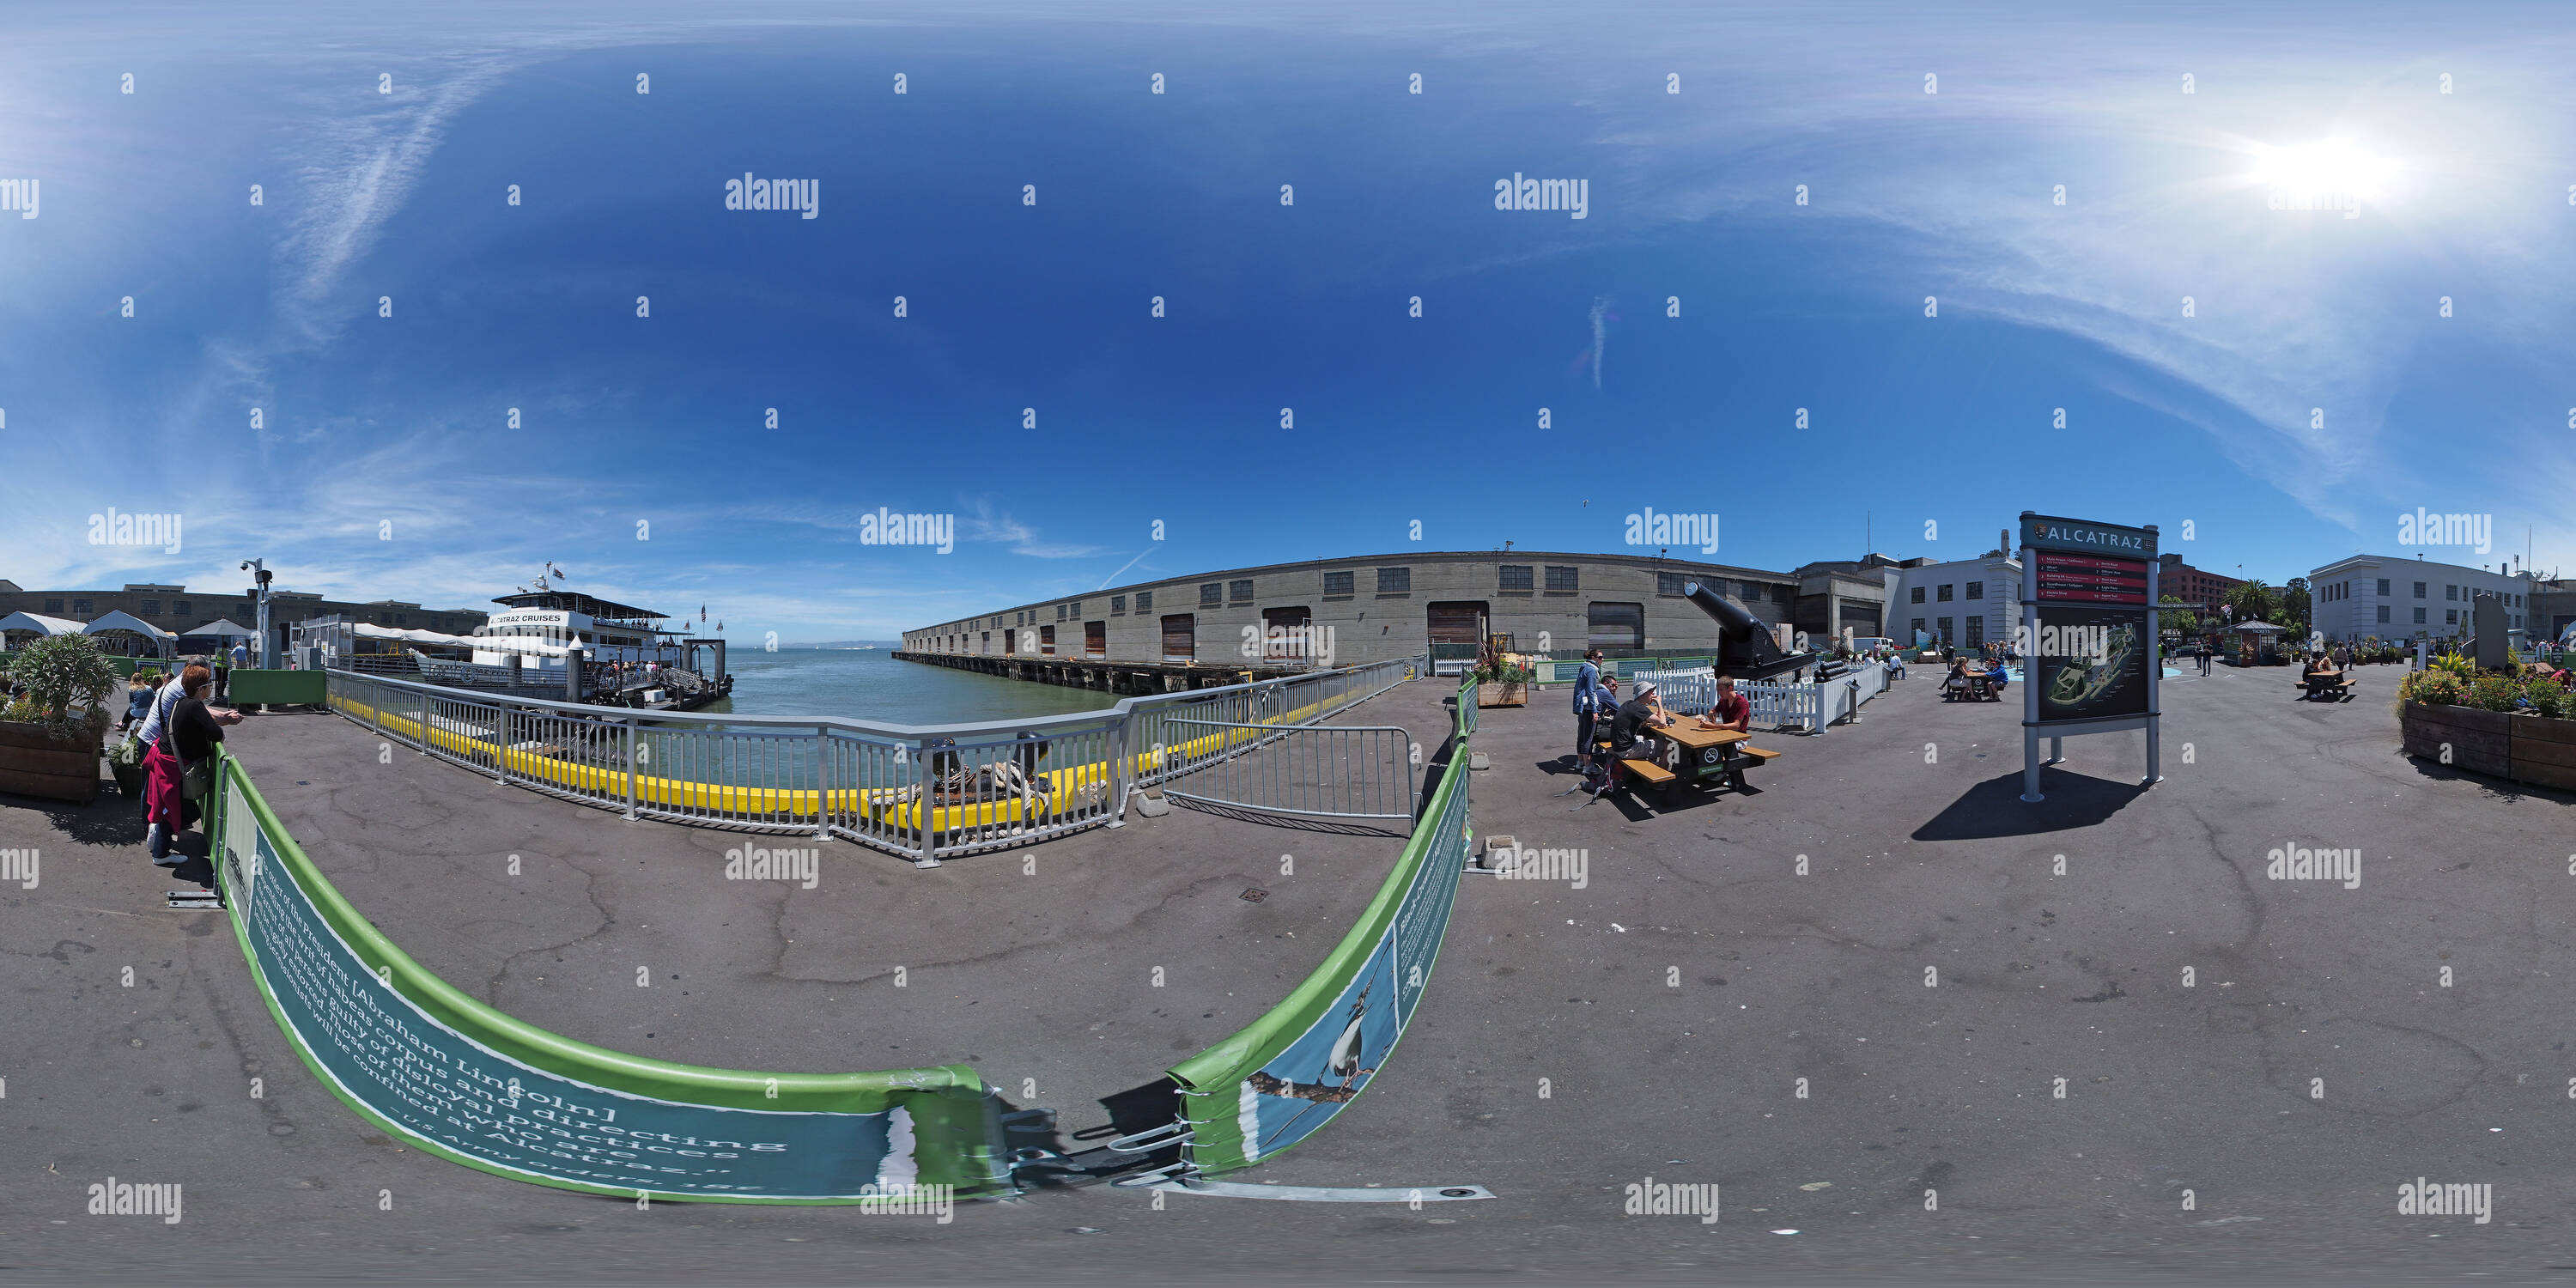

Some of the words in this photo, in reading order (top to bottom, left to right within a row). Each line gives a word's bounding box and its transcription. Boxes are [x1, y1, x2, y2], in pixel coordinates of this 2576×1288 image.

[490, 616, 520, 624] ALCATRAZ
[2047, 526, 2142, 550] ALCATRAZ
[263, 910, 270, 927] be
[289, 957, 326, 1014] enforced.
[329, 1010, 365, 1054] Those
[368, 1054, 387, 1071] of
[391, 1069, 454, 1112] them
[462, 1109, 543, 1141] who
[556, 1141, 639, 1159] are
[269, 871, 283, 897] order
[283, 895, 291, 908] of
[291, 902, 302, 927] the
[303, 921, 349, 987] President
[353, 980, 448, 1064] [Abraham
[456, 1059, 616, 1123] Lincoln]
[278, 923, 285, 936] of
[284, 935, 294, 951] all
[295, 949, 327, 997] persons
[330, 997, 368, 1038] guilty
[370, 1040, 390, 1057] of
[392, 1057, 495, 1115] disloyal
[506, 1113, 739, 1159] practices
[286, 914, 297, 938] the
[298, 934, 315, 963] writ
[316, 962, 326, 978] of
[328, 972, 373, 1027] habeas
[376, 1028, 448, 1078] corpus
[456, 1078, 520, 1111] and
[532, 1109, 788, 1152] directing
[313, 1008, 333, 1037] will
[335, 1033, 350, 1054] be
[353, 1054, 439, 1116] confined
[447, 1115, 476, 1133] at
[440, 1134, 521, 1160] Army
